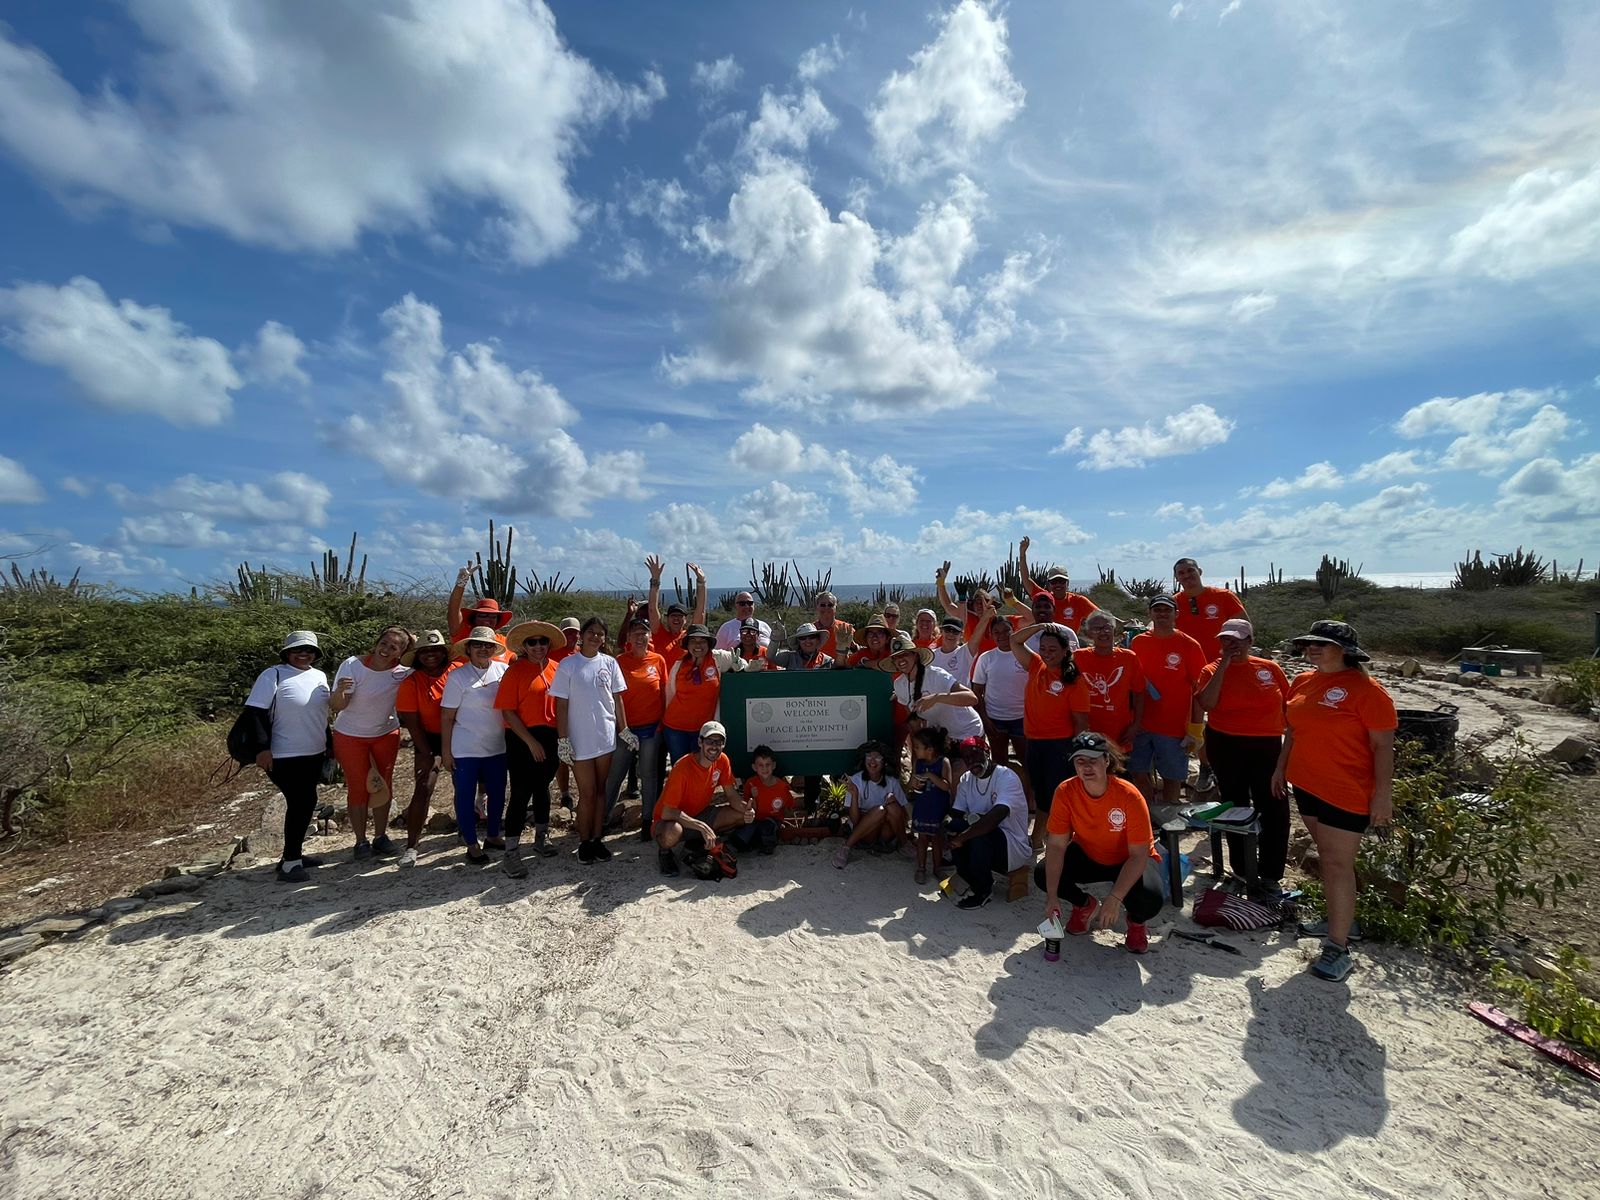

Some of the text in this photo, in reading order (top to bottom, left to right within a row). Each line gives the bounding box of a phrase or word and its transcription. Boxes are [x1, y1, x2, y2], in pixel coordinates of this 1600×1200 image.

[786, 700, 805, 708] BON
[784, 709, 830, 717] WELCOME
[765, 724, 848, 734] PEACE LABYRINTH
